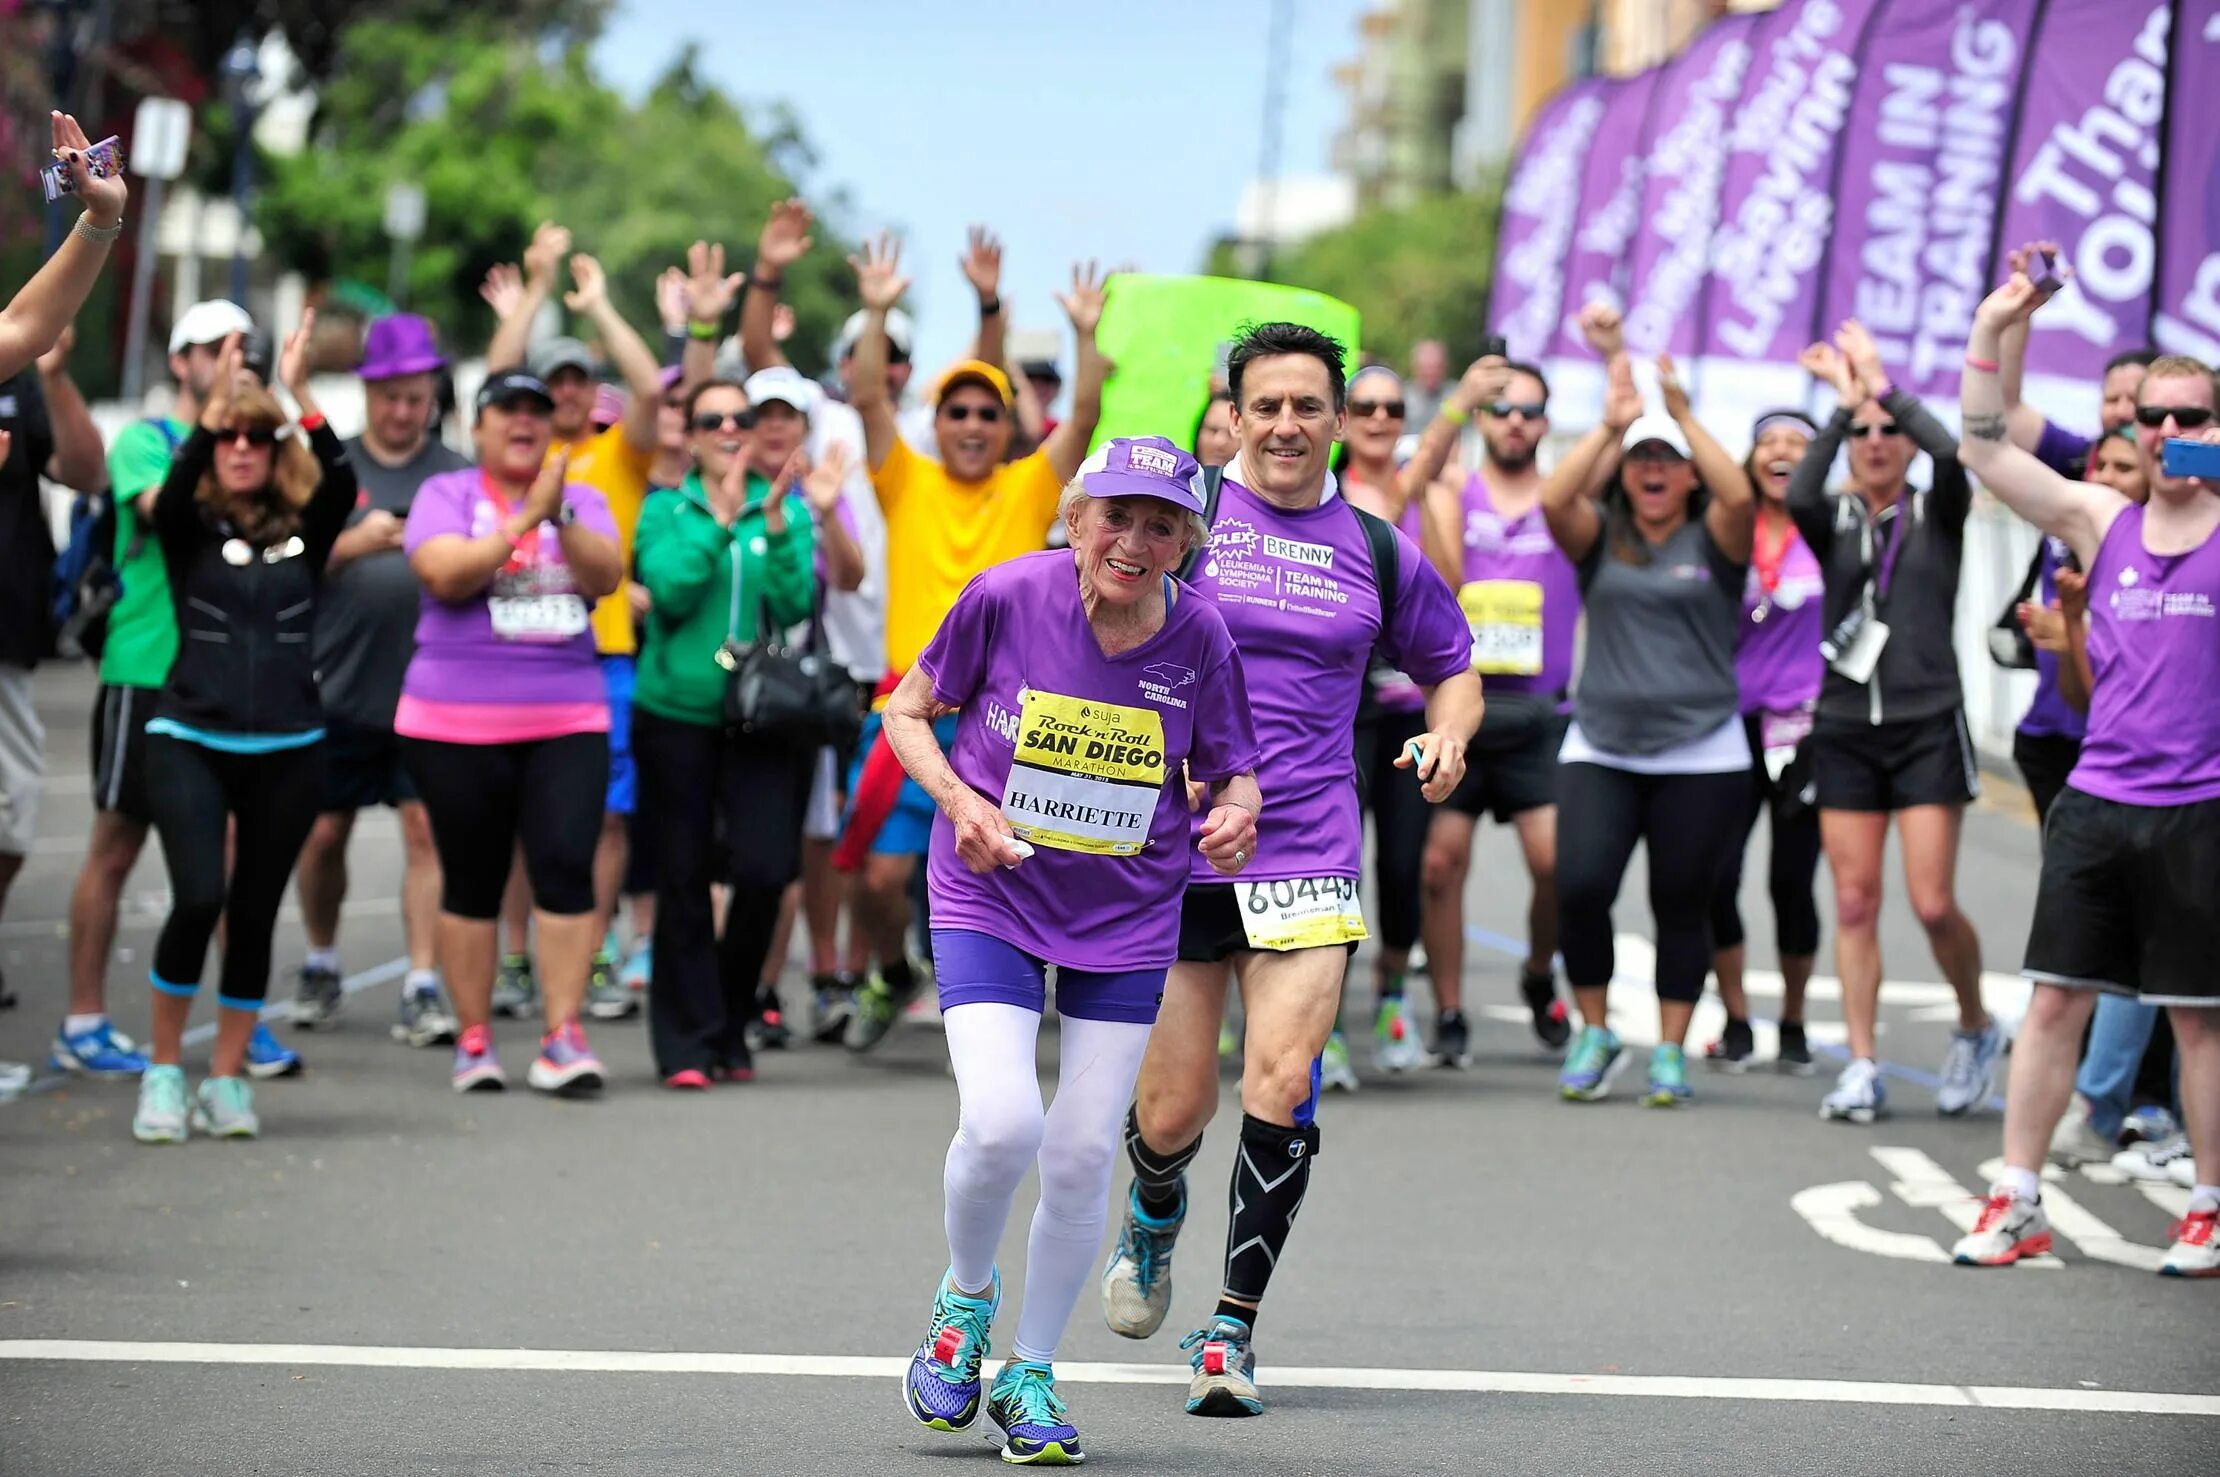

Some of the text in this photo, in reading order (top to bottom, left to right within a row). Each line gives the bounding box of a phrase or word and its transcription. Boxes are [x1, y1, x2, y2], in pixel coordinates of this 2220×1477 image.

[1877, 61, 1945, 147] IN
[1913, 18, 2017, 384] TRAINING
[1131, 453, 1175, 473] TEAM
[1213, 531, 1251, 546] FLEX
[1267, 537, 1332, 565] BRENNY
[1219, 568, 1272, 583] LYMPHOMA
[1220, 559, 1266, 573] LEUKEMIA
[1218, 577, 1259, 589] SOCIETY
[1285, 570, 1338, 590] TEAM IN
[1284, 582, 1348, 604] TRAINING
[1137, 680, 1171, 695] NORTH
[1144, 691, 1188, 709] CAROLINA
[1093, 710, 1121, 724] suja
[1038, 714, 1093, 738] Rock
[1110, 728, 1153, 747] Roll
[1023, 730, 1162, 769] SAN DIEGO
[1052, 757, 1127, 777] MARATHON
[1008, 790, 1143, 830] HARRIETTE
